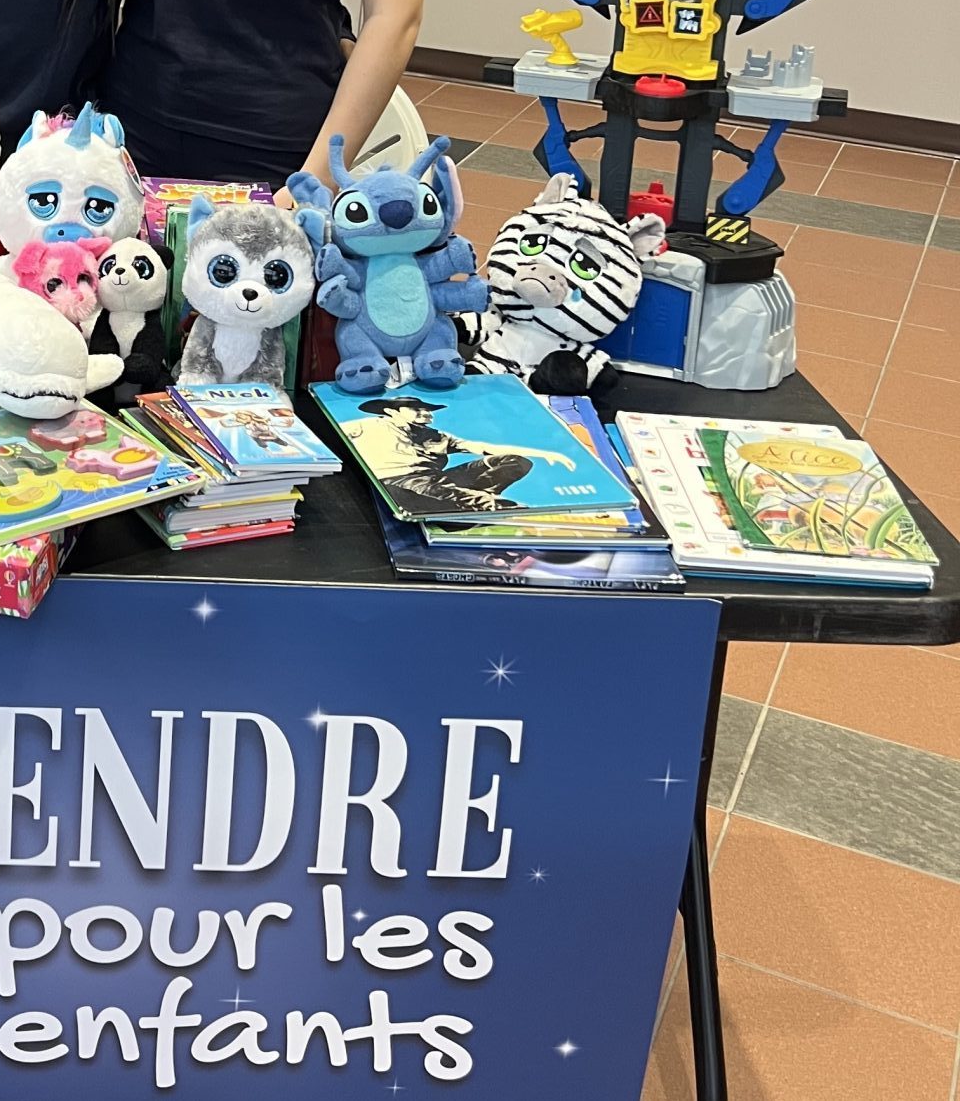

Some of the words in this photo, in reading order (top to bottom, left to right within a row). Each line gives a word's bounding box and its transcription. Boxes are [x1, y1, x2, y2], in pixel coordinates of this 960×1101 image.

[208, 388, 269, 398] Nick
[752, 446, 848, 466] Alice
[322, 884, 495, 980] les
